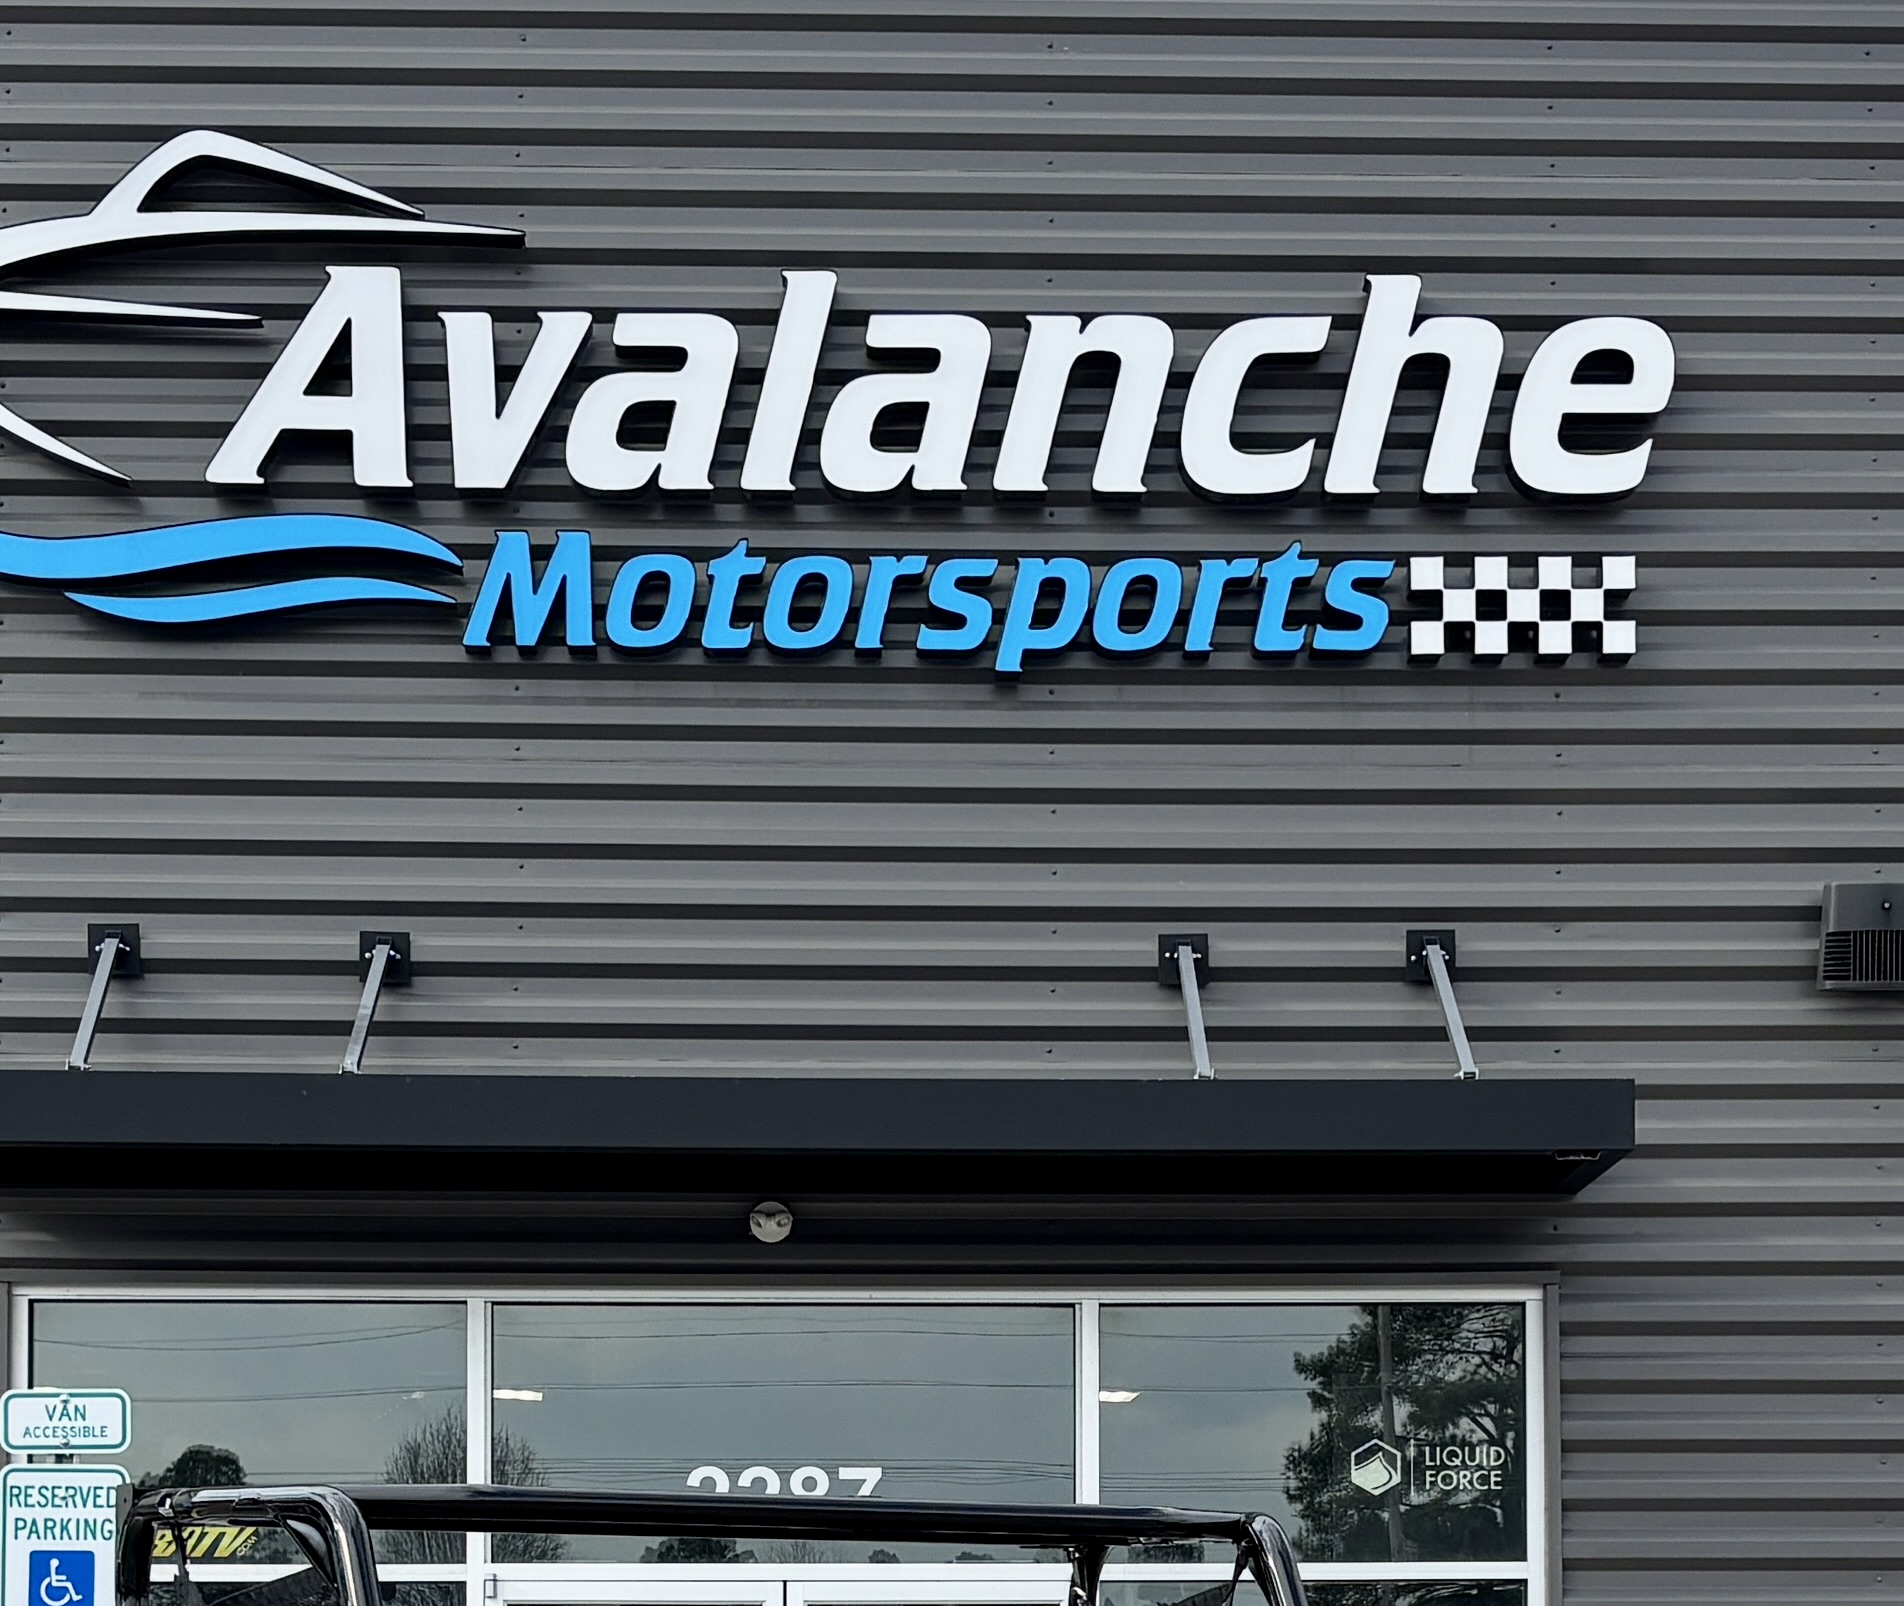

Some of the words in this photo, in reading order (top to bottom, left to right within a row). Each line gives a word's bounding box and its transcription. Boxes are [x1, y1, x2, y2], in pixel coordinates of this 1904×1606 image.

[206, 265, 1675, 494] Avalanche
[462, 530, 1396, 675] Motorsports
[45, 1403, 87, 1422] VAN
[23, 1426, 108, 1438] ACCESSIBLE
[1425, 1446, 1505, 1466] LIQUID
[1425, 1470, 1502, 1490] FORCE
[10, 1485, 117, 1508] RESERVED
[14, 1517, 114, 1541] PARKING
